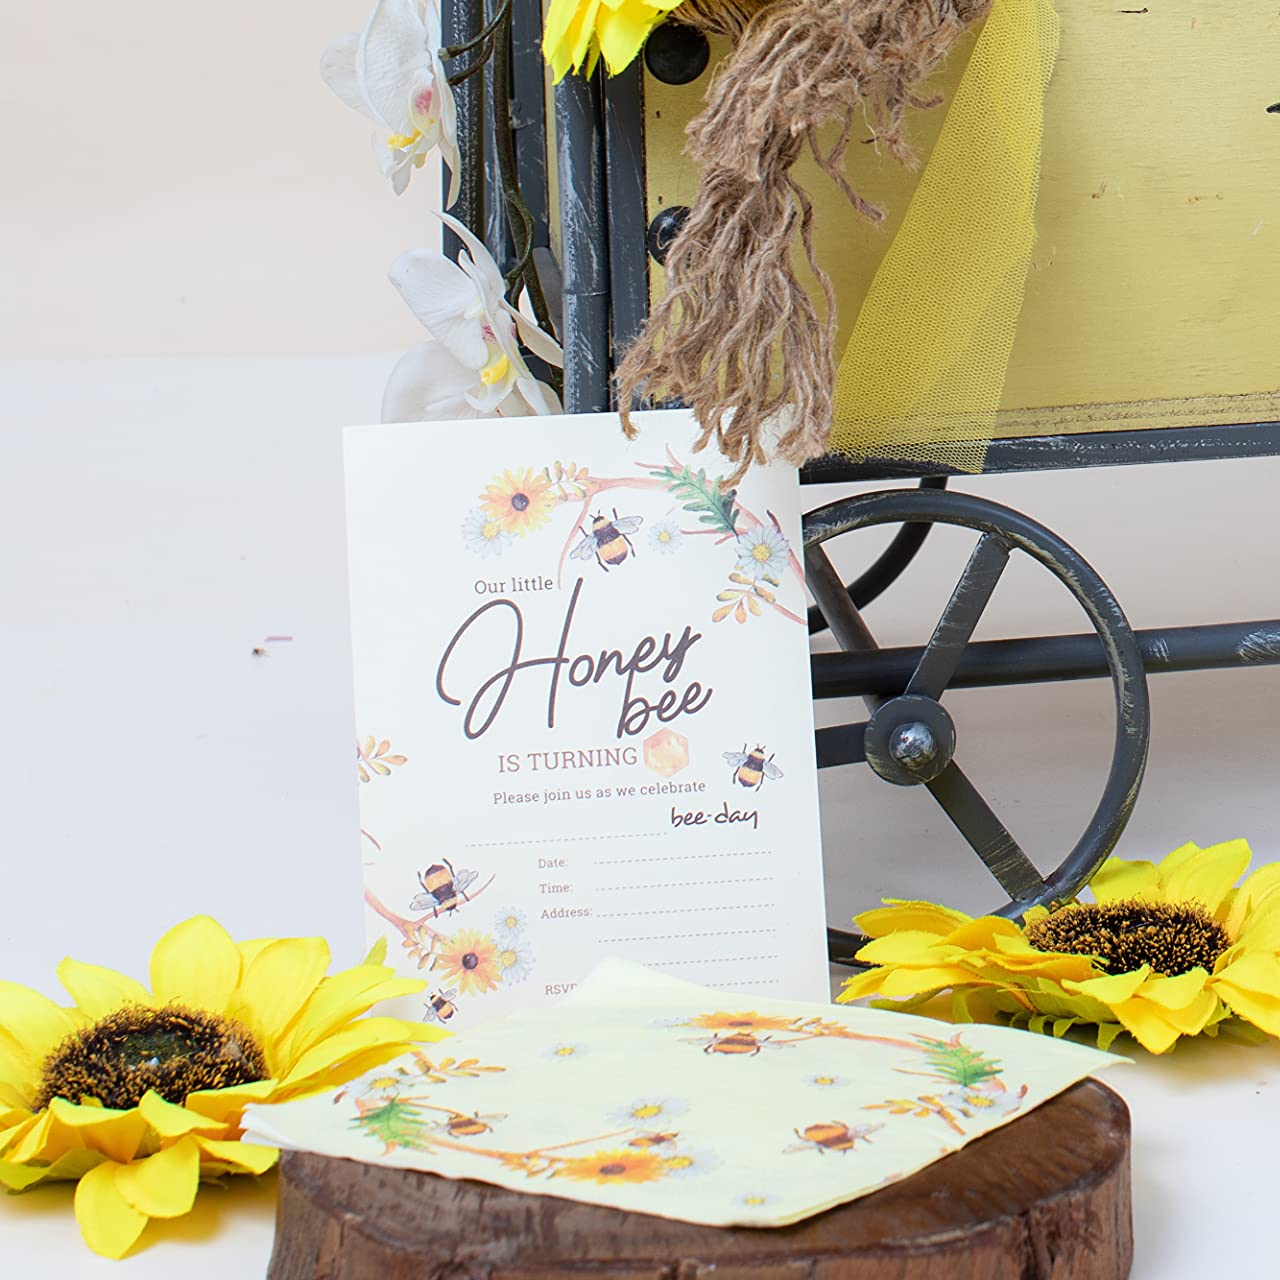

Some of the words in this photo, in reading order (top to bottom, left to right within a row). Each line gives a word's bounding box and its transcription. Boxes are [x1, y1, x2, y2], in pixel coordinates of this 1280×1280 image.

[474, 578, 507, 595] Our
[511, 576, 554, 593] little
[436, 577, 702, 739] Honey
[616, 666, 713, 739] bee
[498, 754, 521, 773] IS
[527, 747, 639, 771] TURNING
[493, 789, 541, 806] Please
[543, 787, 572, 805] join
[575, 788, 593, 801] us
[596, 787, 613, 799] as
[616, 785, 637, 798] we
[640, 780, 708, 797] celebrate
[671, 802, 760, 830] bee-day
[538, 857, 569, 870] Date:
[539, 882, 573, 895] Time:
[541, 907, 593, 920] Address:
